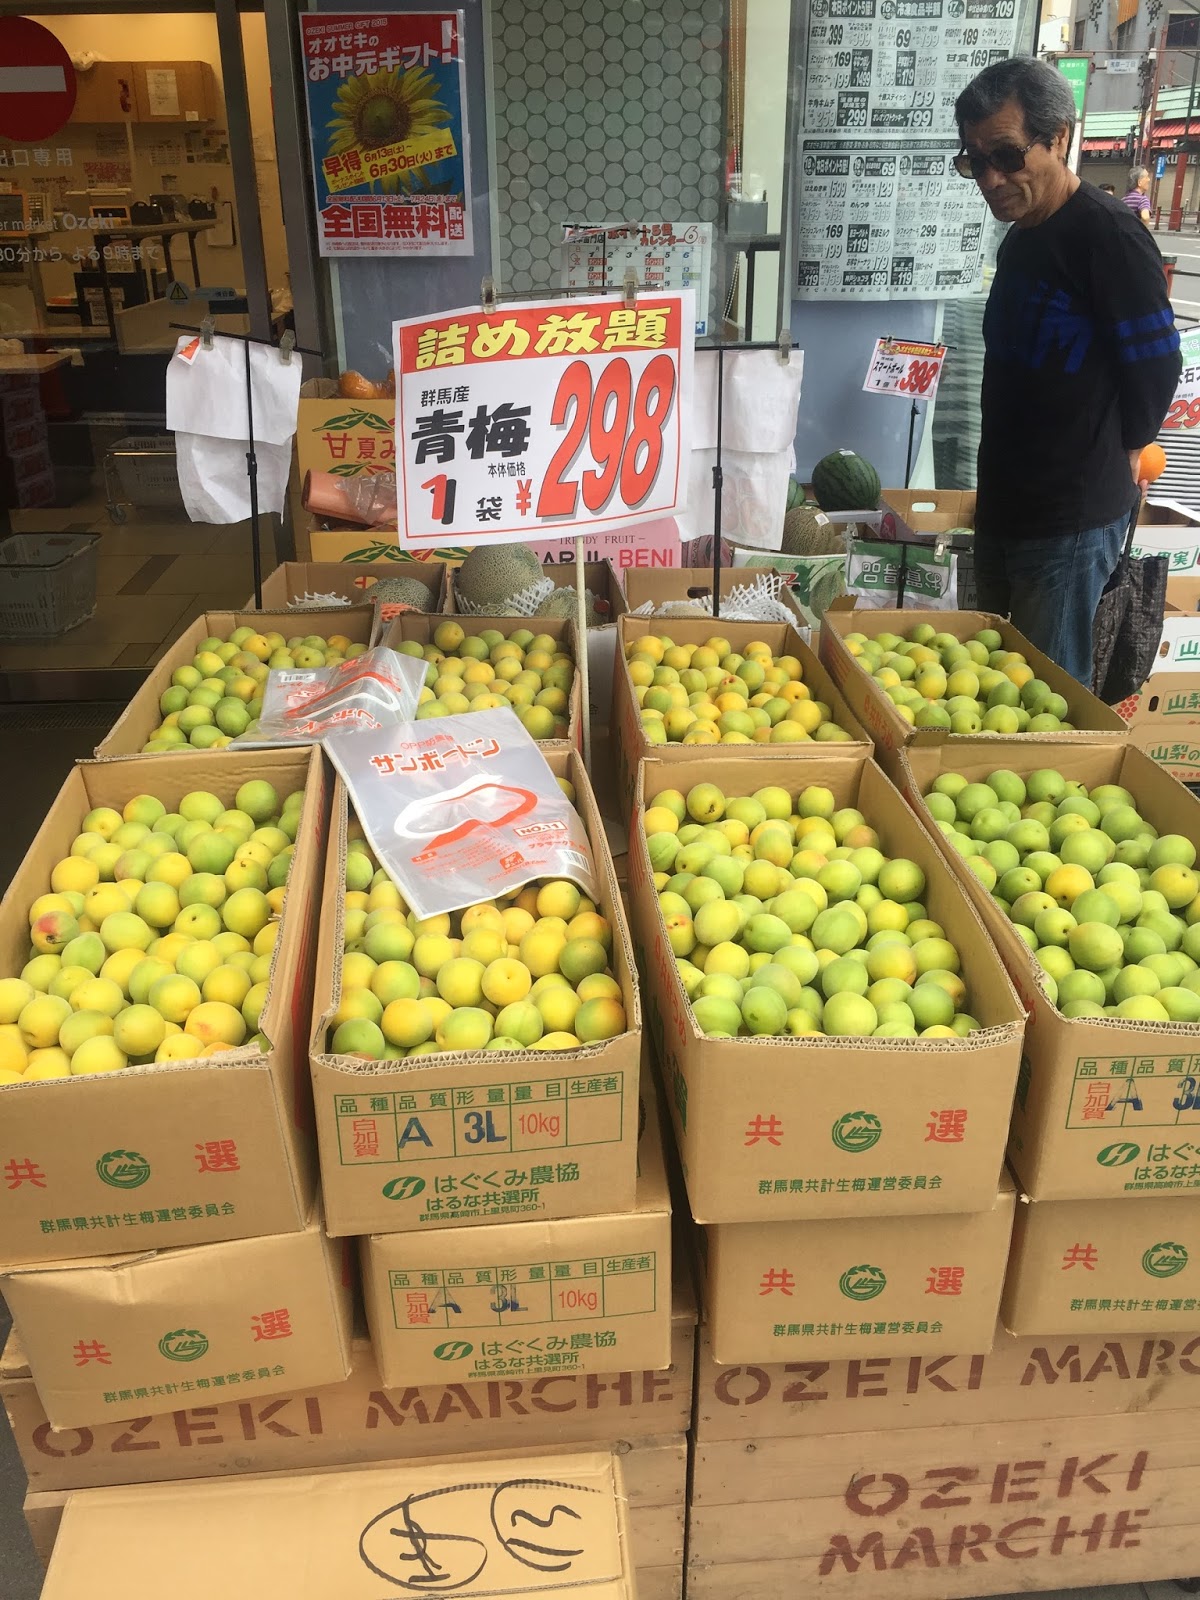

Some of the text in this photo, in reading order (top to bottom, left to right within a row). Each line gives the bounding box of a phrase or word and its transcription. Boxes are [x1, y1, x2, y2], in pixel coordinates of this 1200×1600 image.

[996, 1, 1014, 18] 109
[308, 33, 379, 54] オオゼキの
[896, 29, 912, 48] 69
[834, 51, 852, 67] 169
[970, 49, 988, 67] 169
[847, 109, 867, 126] 299
[906, 110, 932, 127] 199
[324, 149, 362, 178] 早得
[12, 217, 58, 231] market
[62, 213, 115, 230] Ozeki
[320, 204, 448, 239] 全国無料
[448, 206, 464, 237] 配送
[684, 225, 698, 242] 6
[825, 224, 844, 238] 169
[415, 306, 672, 370] 詰め放題
[899, 359, 939, 393] 398
[420, 385, 470, 407] 群馬産
[411, 402, 532, 465] 青梅
[421, 353, 677, 525] 1 袋 ¥ 298
[487, 462, 526, 478] 本体価格
[559, 535, 636, 545] TREDY FRUIT
[619, 548, 673, 568] BENI
[369, 736, 501, 776] サンボードン
[1079, 1060, 1128, 1077] 品種
[1136, 1058, 1186, 1075] 品質
[339, 1095, 390, 1114] 品種
[399, 1091, 448, 1111] 品質
[514, 1082, 562, 1101] 量目
[570, 1076, 618, 1096] 生産者
[1081, 1081, 1112, 1121] 白加賀
[352, 1110, 561, 1158] 白加賀 A 3L 10kg
[744, 1109, 968, 1147] 共 選
[4, 1138, 241, 1190] 共 選
[433, 1161, 581, 1194] はぐくみ農協
[758, 1174, 943, 1195] 群馬県共計生梅運営委員会
[426, 1187, 541, 1213] はるな共選所
[39, 1201, 236, 1235] 群馬県共計生梅運営委員会
[392, 1272, 438, 1287] 品種
[447, 1269, 492, 1285] 品質
[553, 1261, 599, 1277] 量目
[606, 1255, 651, 1273] 生産者
[1061, 1242, 1098, 1271] 共
[758, 1266, 965, 1297] 共 選
[406, 1291, 431, 1325] 白加賀
[557, 1289, 598, 1311] 10kg
[1070, 1298, 1200, 1312] 群馬県共計生梅運営
[73, 1308, 294, 1367] 共 選
[481, 1330, 618, 1357] はぐくみ農協
[773, 1321, 944, 1337] 群馬県共計生梅運営委員会
[474, 1351, 580, 1371] はるな共選所
[103, 1364, 286, 1404] 群馬県共計生梅運営委員会
[714, 1353, 985, 1406] OZEKI
[32, 1370, 674, 1459] OZEKI MARCHE
[844, 1450, 1150, 1517] OZEKI
[817, 1509, 1151, 1576] MARCHE
